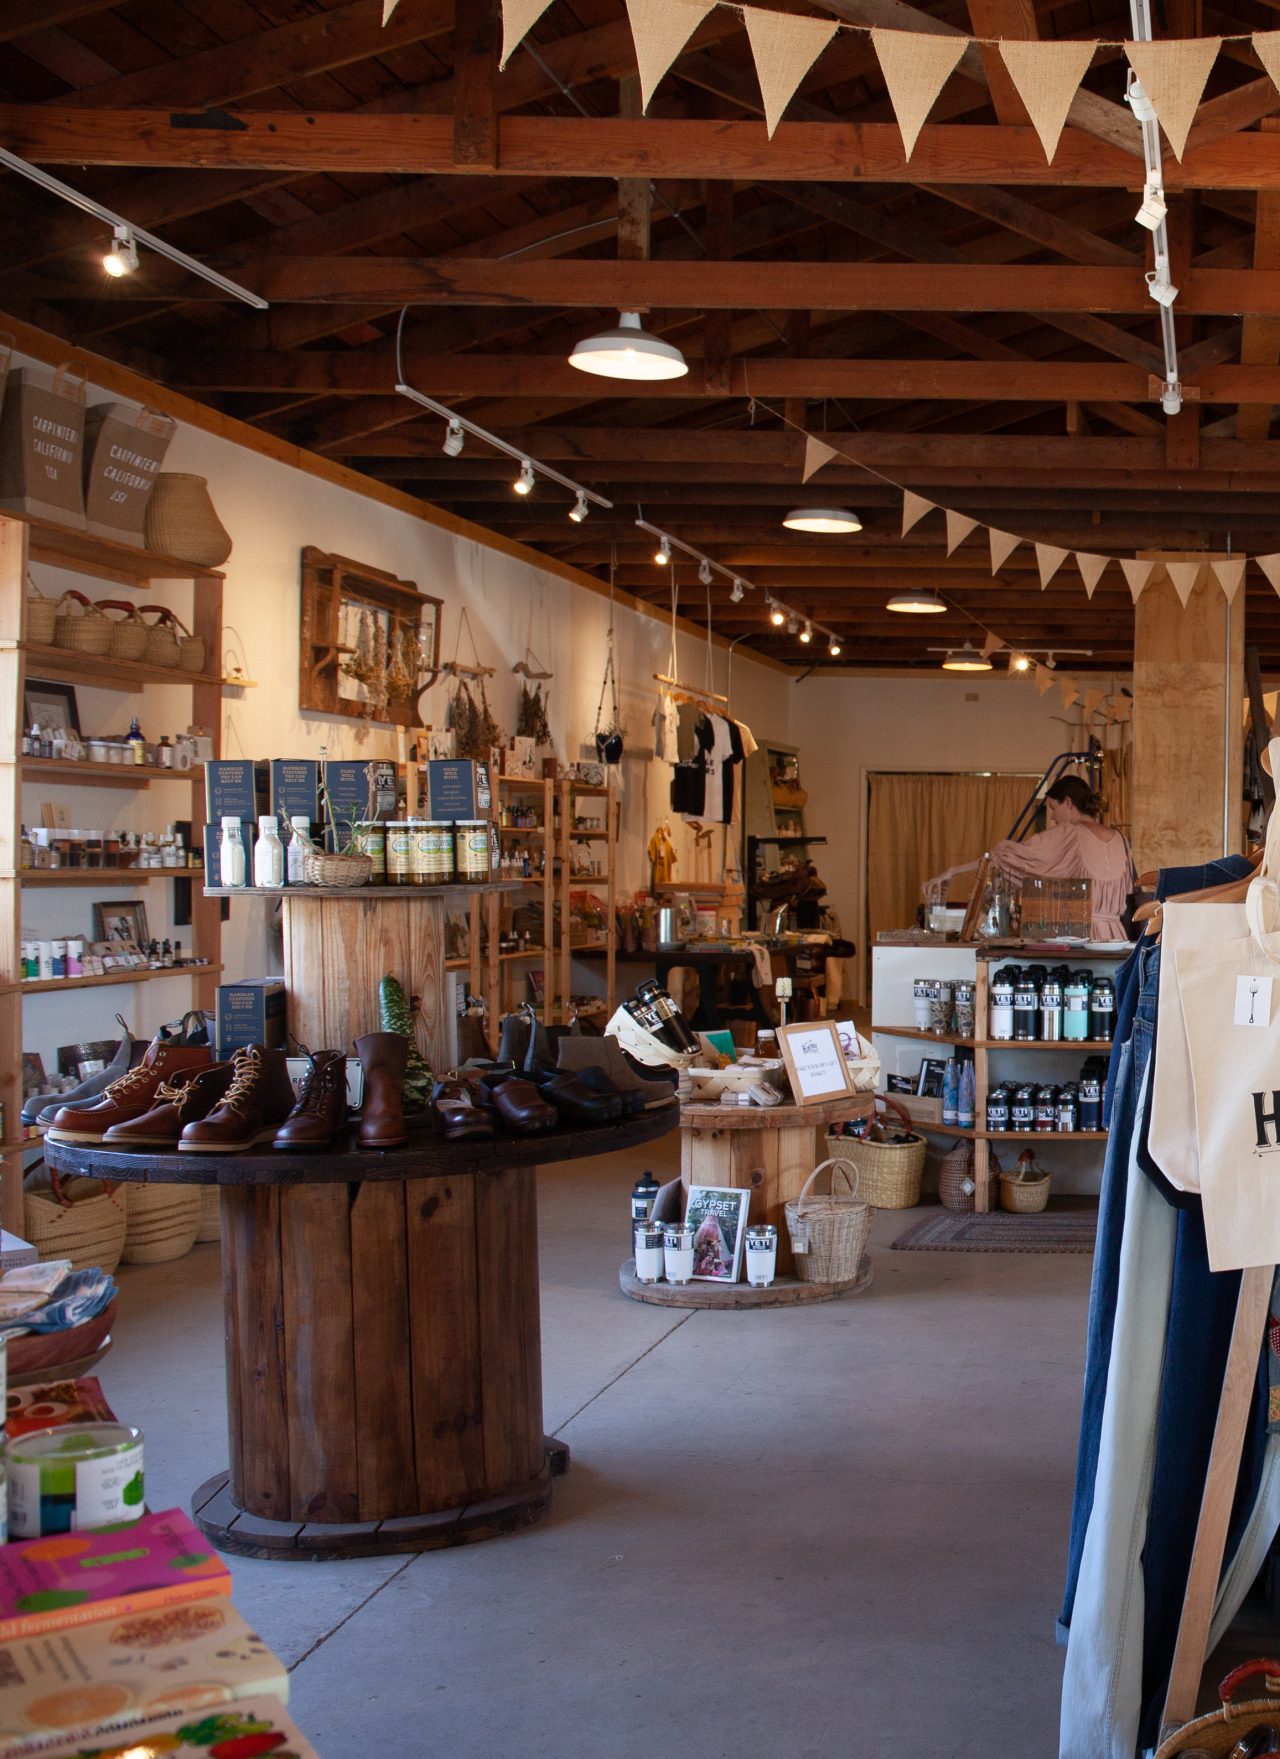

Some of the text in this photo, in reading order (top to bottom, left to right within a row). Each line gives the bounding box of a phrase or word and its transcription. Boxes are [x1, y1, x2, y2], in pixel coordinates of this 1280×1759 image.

[1085, 1086, 1099, 1094] YET
[695, 1200, 736, 1211] GYPSET
[700, 1209, 728, 1217] TRAVEL
[750, 1238, 770, 1246] YETI
